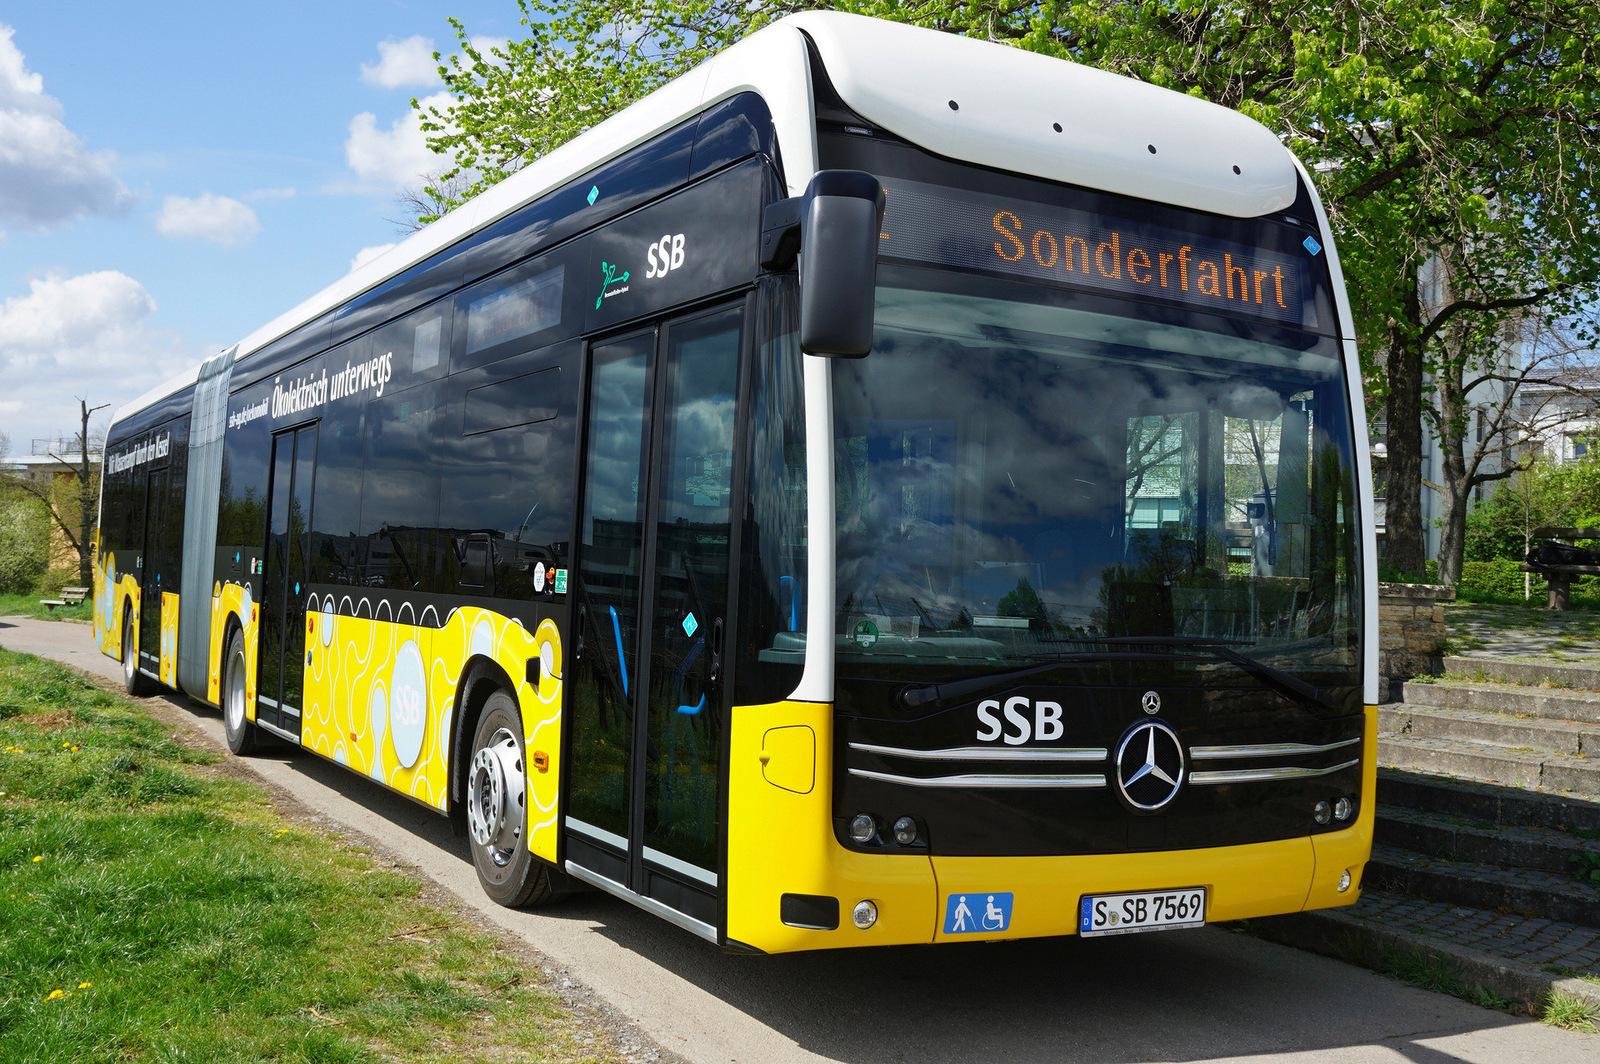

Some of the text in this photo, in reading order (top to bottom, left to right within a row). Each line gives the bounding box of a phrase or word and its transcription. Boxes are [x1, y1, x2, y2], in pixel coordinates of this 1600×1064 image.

[646, 233, 685, 279] SSB
[993, 211, 1287, 308] Sonderfahrt
[272, 352, 393, 419] Ökolektrisch unterwegs
[395, 684, 420, 726] SSB
[976, 696, 1064, 746] SSB
[1094, 901, 1107, 926] S
[1121, 898, 1148, 924] SB
[1153, 893, 1201, 921] 7569
